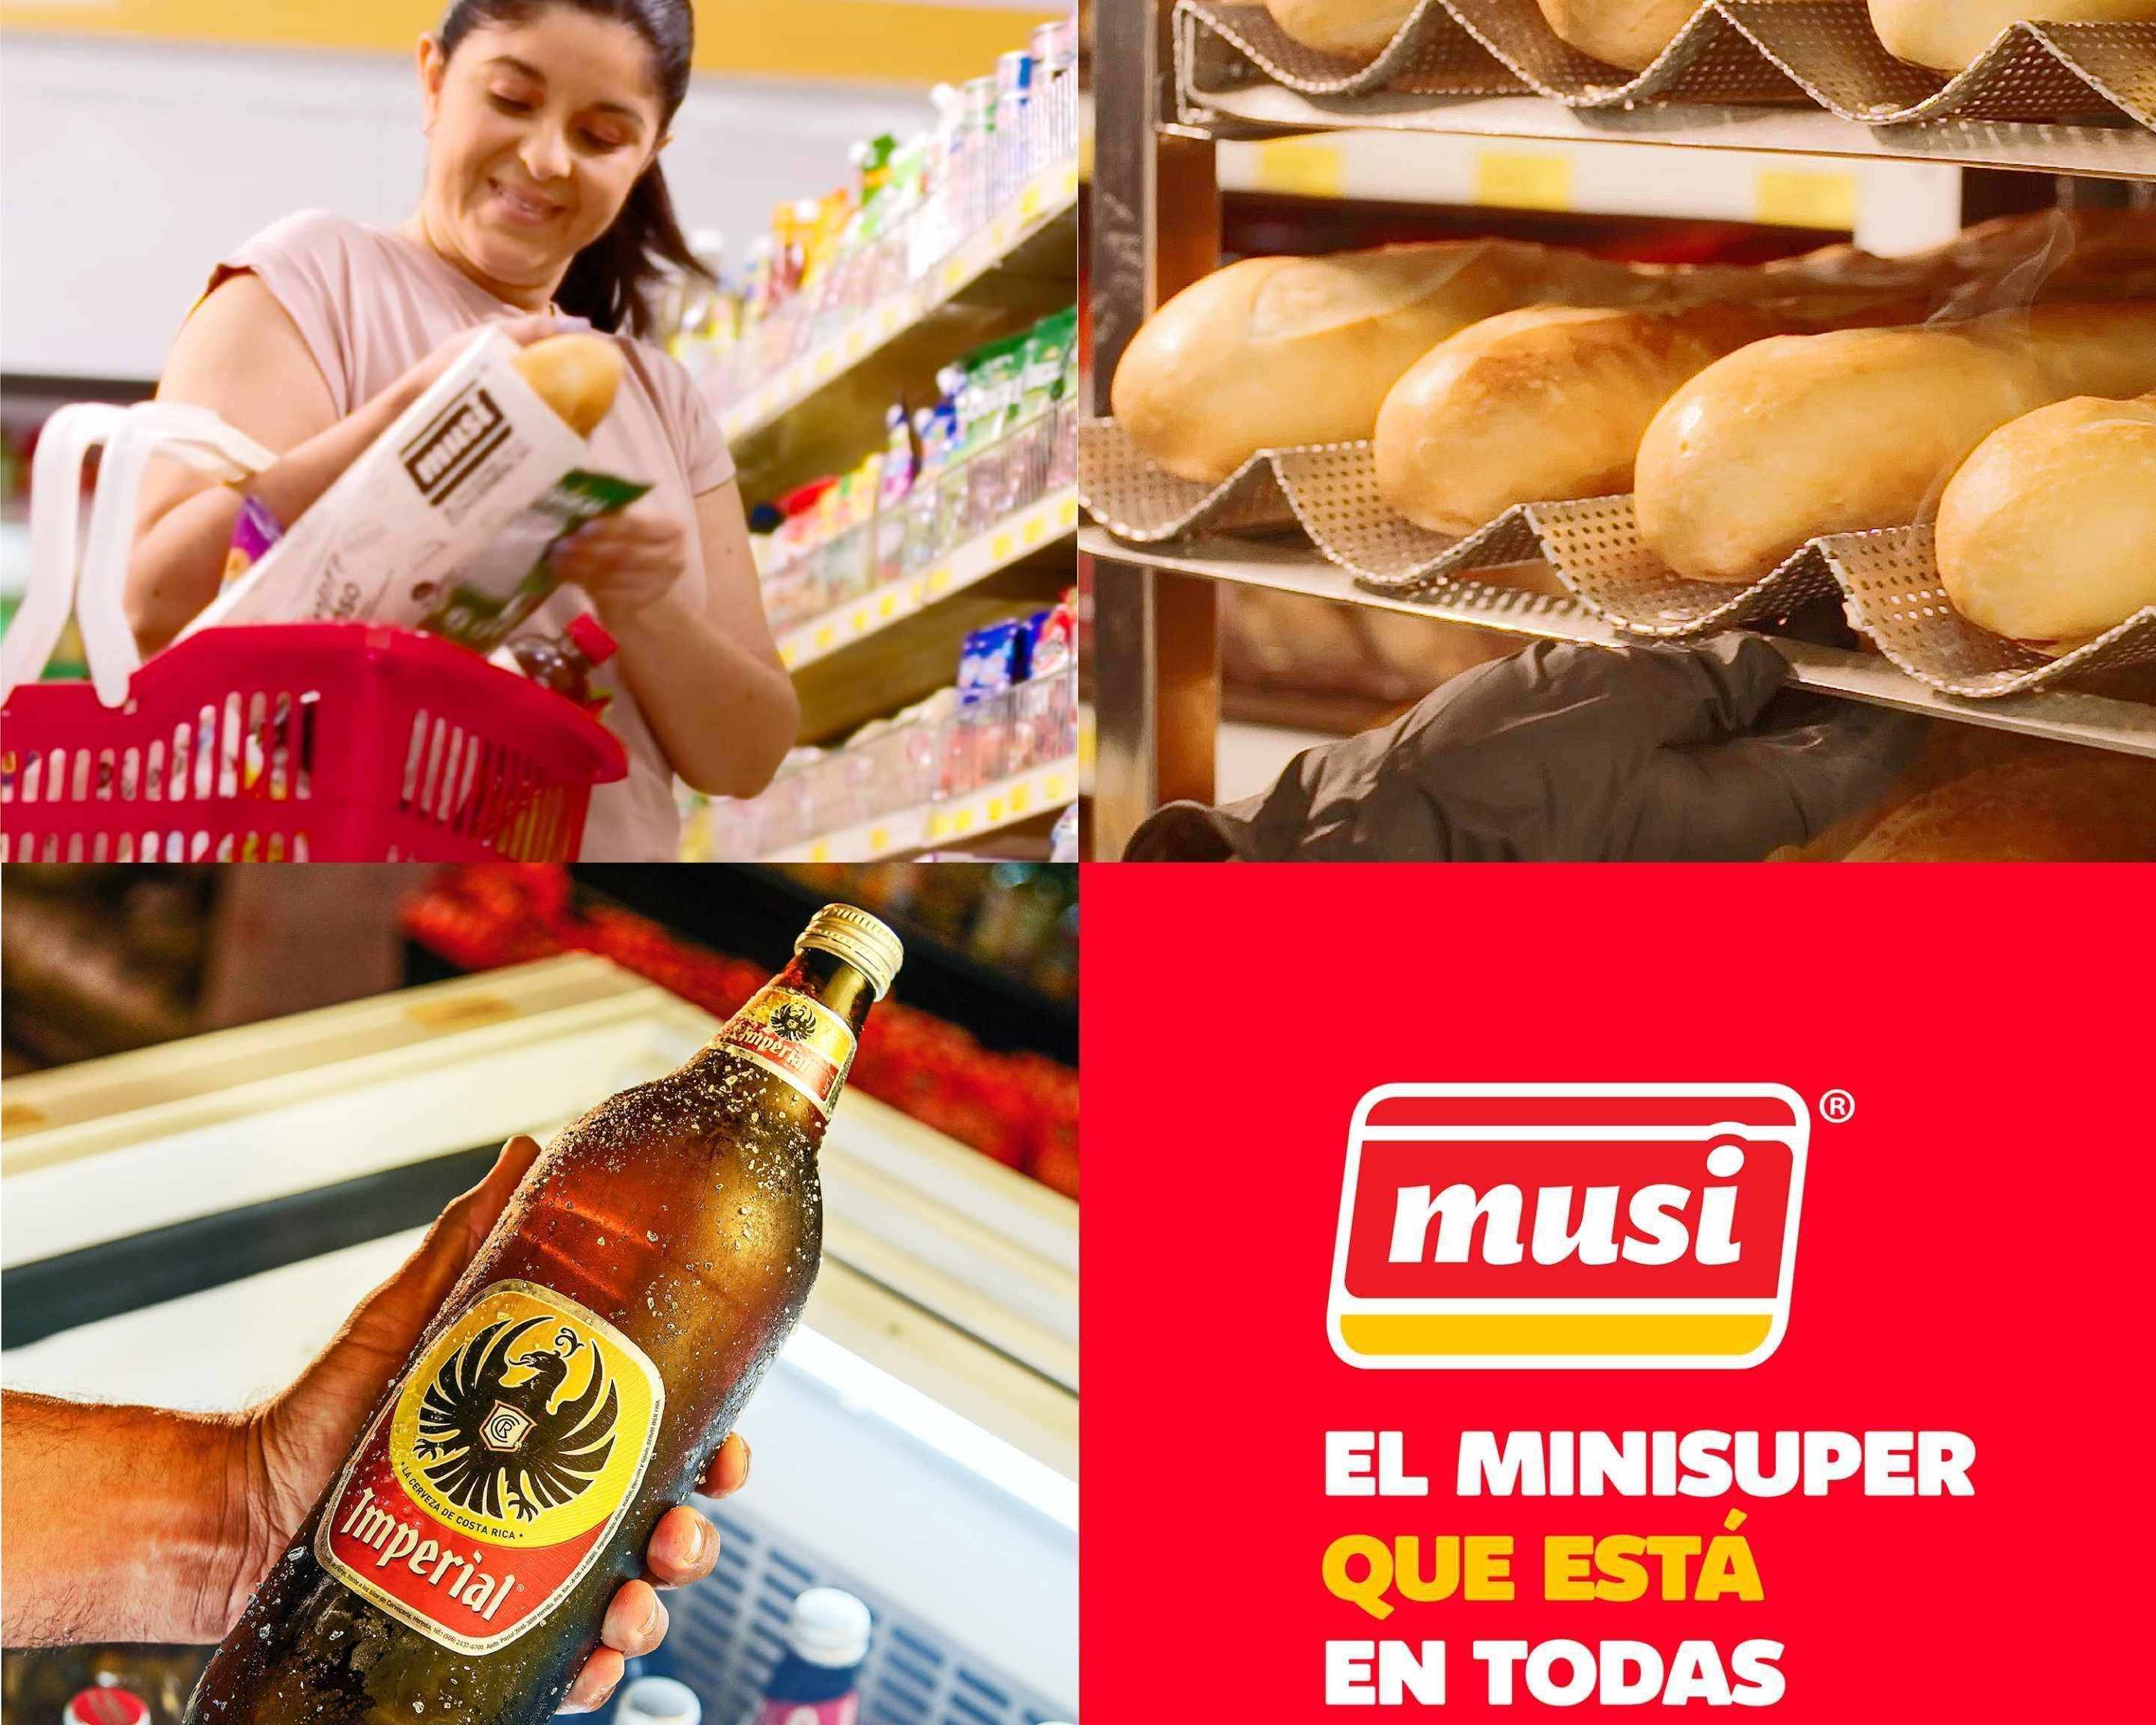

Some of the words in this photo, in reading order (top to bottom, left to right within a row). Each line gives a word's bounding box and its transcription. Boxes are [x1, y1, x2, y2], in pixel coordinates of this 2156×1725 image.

[1389, 1145, 1744, 1265] musi
[402, 1466, 409, 1479] LA
[409, 1479, 440, 1512] CERVEZA
[441, 1508, 456, 1521] DE
[456, 1516, 488, 1535] COSTA
[491, 1528, 515, 1539] RICA
[1326, 1431, 1428, 1497] EL
[1457, 1430, 1976, 1497] MINISUPER
[341, 1488, 516, 1621] Imperial
[1323, 1535, 1514, 1619] QUE
[1545, 1509, 1764, 1601] ESTÁ
[1326, 1640, 1446, 1706] EN
[1473, 1639, 1785, 1706] TODAS
